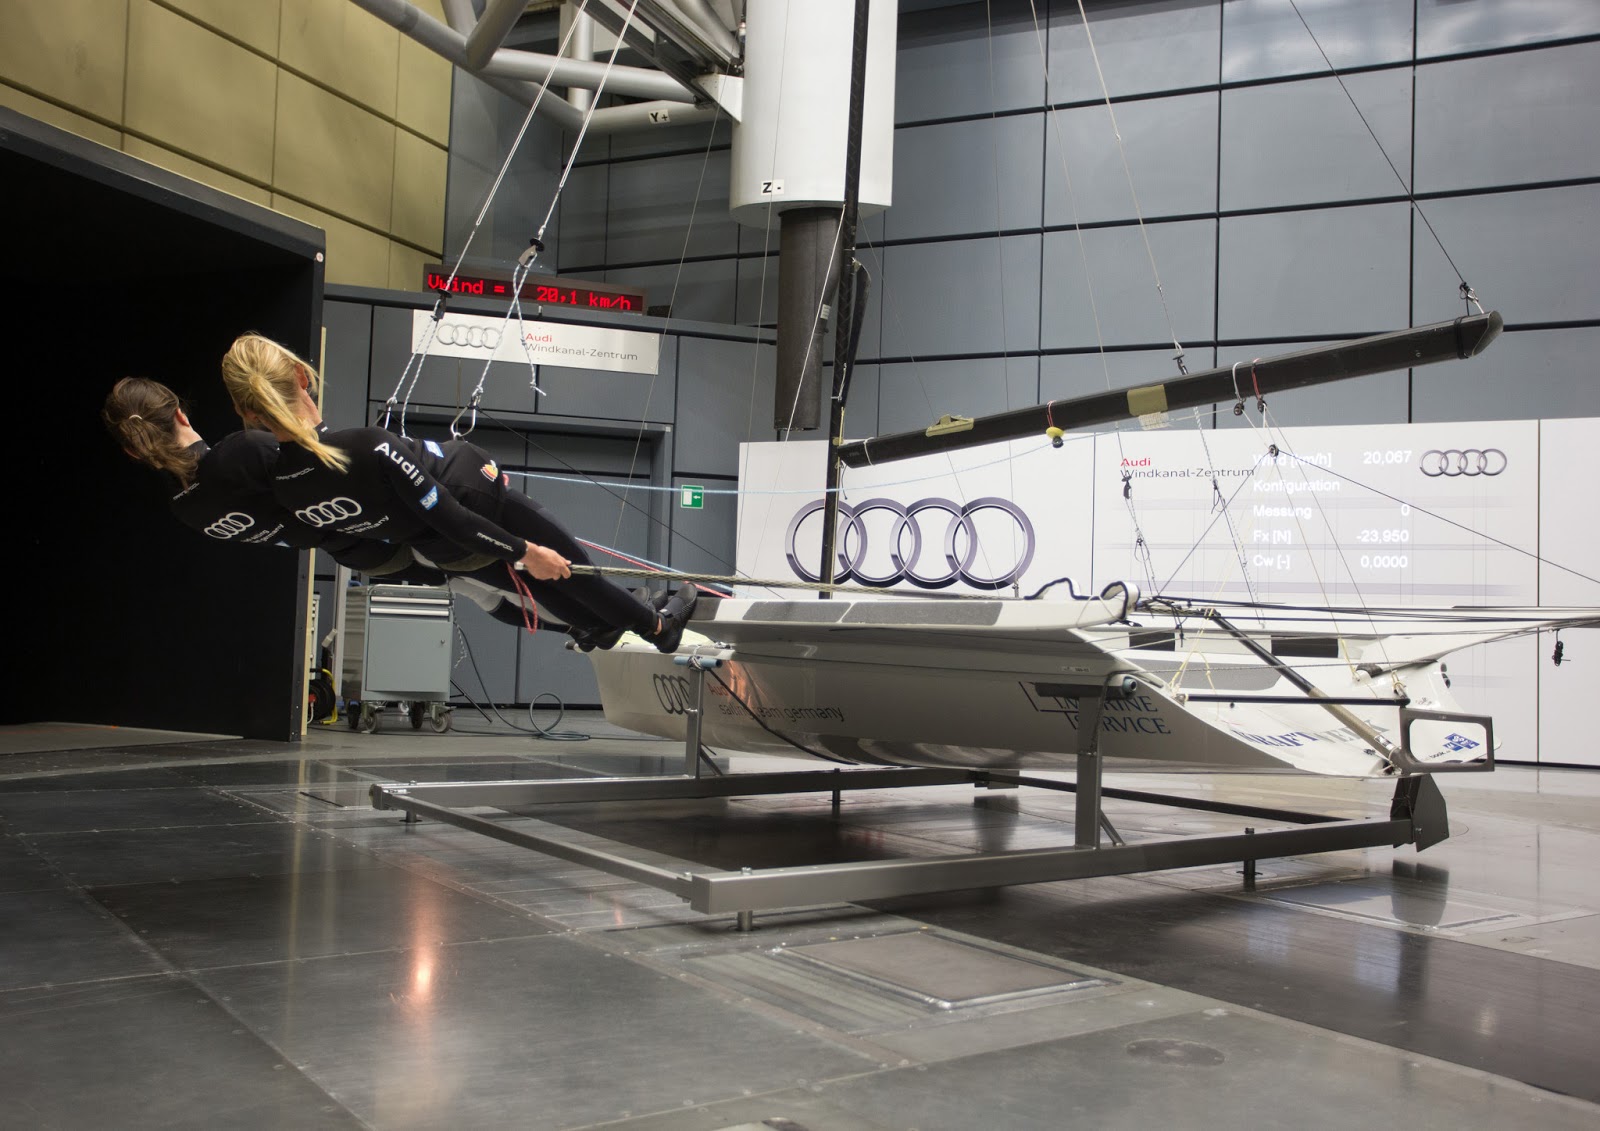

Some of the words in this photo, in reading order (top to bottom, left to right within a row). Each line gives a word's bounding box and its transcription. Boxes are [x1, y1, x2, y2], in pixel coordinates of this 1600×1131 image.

[427, 274, 484, 295] Vwind
[589, 295, 632, 311] km/h
[525, 332, 553, 343] Audi
[525, 343, 638, 361] Windkanal-Zentrum
[374, 442, 420, 480] Audi
[1120, 458, 1151, 467] Audi
[1363, 450, 1412, 465] 20,067
[1120, 468, 1255, 478] Windkanal-Zentrum
[1253, 479, 1341, 494] Konfiguration
[421, 491, 438, 509] SAP
[1253, 505, 1312, 519] Messung
[1400, 503, 1411, 516] 0
[1253, 530, 1269, 542] Fx
[1272, 530, 1292, 544] [N]
[1356, 529, 1409, 544] -23,950
[1252, 555, 1274, 567] Cw
[1276, 555, 1291, 569] [-]
[1360, 555, 1408, 568] 0,0000
[707, 682, 731, 697] Aud
[784, 705, 845, 722] germany
